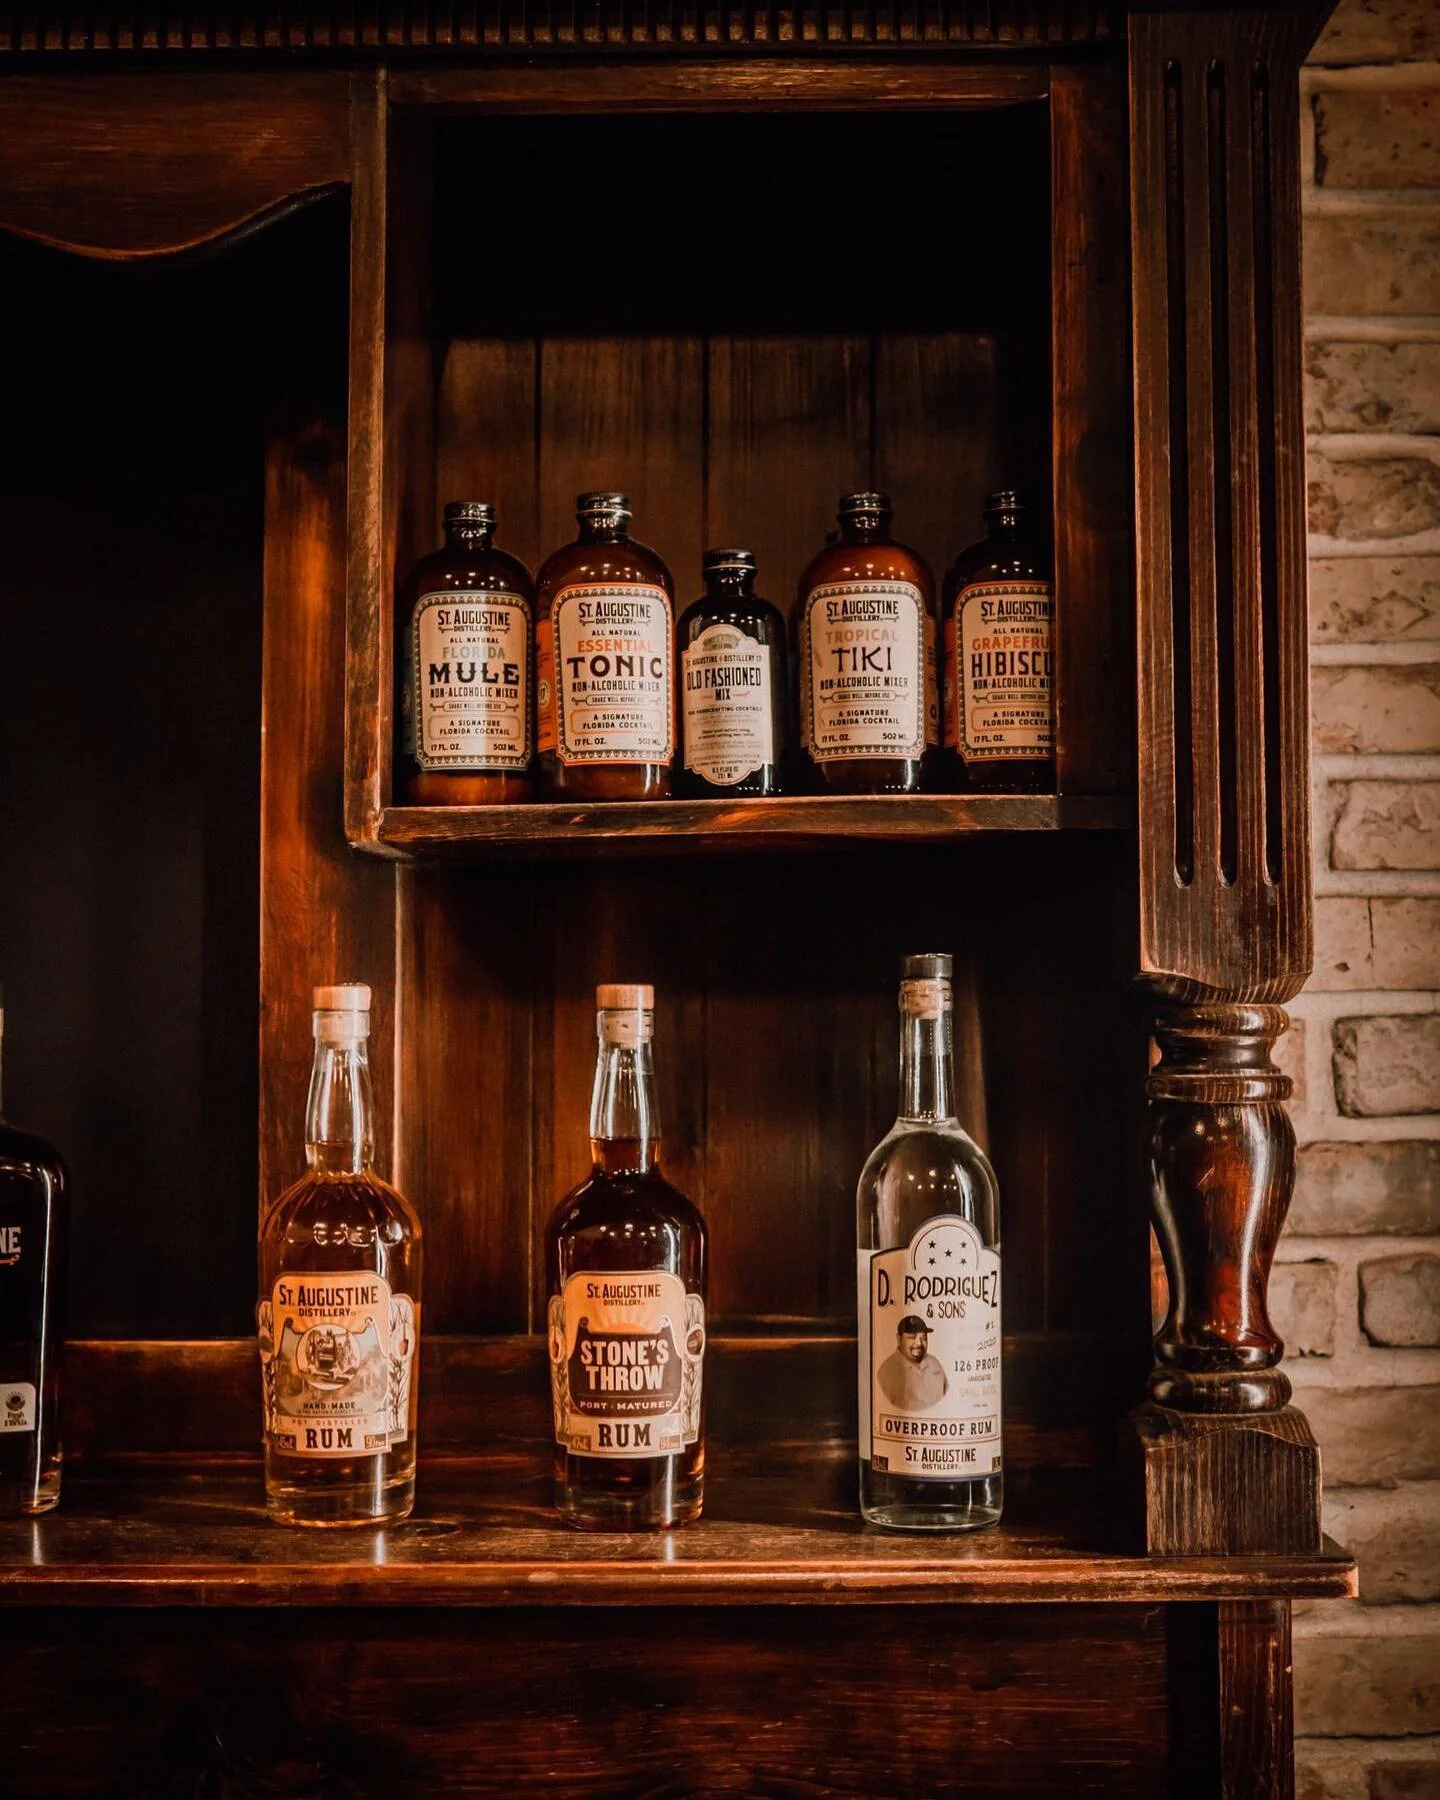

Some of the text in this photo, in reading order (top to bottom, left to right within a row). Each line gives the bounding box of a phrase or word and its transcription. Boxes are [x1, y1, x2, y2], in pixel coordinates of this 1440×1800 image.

[578, 601, 651, 618] ST. AUGUSTINE
[842, 599, 899, 615] AUGUSTINE
[981, 601, 995, 616] ST.
[454, 609, 510, 626] AUGUSTINE
[824, 628, 898, 644] TROPICAL
[972, 635, 1049, 651] GRAPEFRU
[443, 646, 505, 659] FLORIDA
[577, 639, 653, 653] ESSENTIAL
[566, 655, 663, 679] TONIC
[831, 646, 892, 672] TIKI
[429, 662, 520, 686] MULE
[686, 667, 761, 691] OLD FASHIONED
[572, 680, 660, 692] NON-ALCOHOLIC MIXER
[820, 676, 908, 690] NON-ALCOHOLIC MIXER
[973, 677, 1037, 689] NON-ALCOHOLIC
[430, 687, 518, 699] NON-ALCOHOLIC MIXER
[715, 688, 730, 700] MIX
[829, 717, 899, 726] FLORIDA COCKTAIL
[574, 738, 581, 746] 17
[882, 732, 897, 740] 502
[279, 1284, 378, 1306] ST. AUGUSTINE
[602, 1283, 661, 1299] AUGUSTINE
[877, 1269, 997, 1308] D. RODRIGUEZ
[299, 1307, 350, 1317] DISTILLERY
[926, 1301, 965, 1318] & SONS
[580, 1339, 670, 1366] STONE'S
[954, 1360, 972, 1372] 126
[585, 1364, 665, 1391] THROW
[580, 1400, 672, 1410] PORT MATURED
[598, 1423, 651, 1447] RUM
[885, 1420, 992, 1436] OVERPROOF RUM
[305, 1428, 353, 1449] RUM
[905, 1446, 976, 1463] ST. AUGUSTINE
